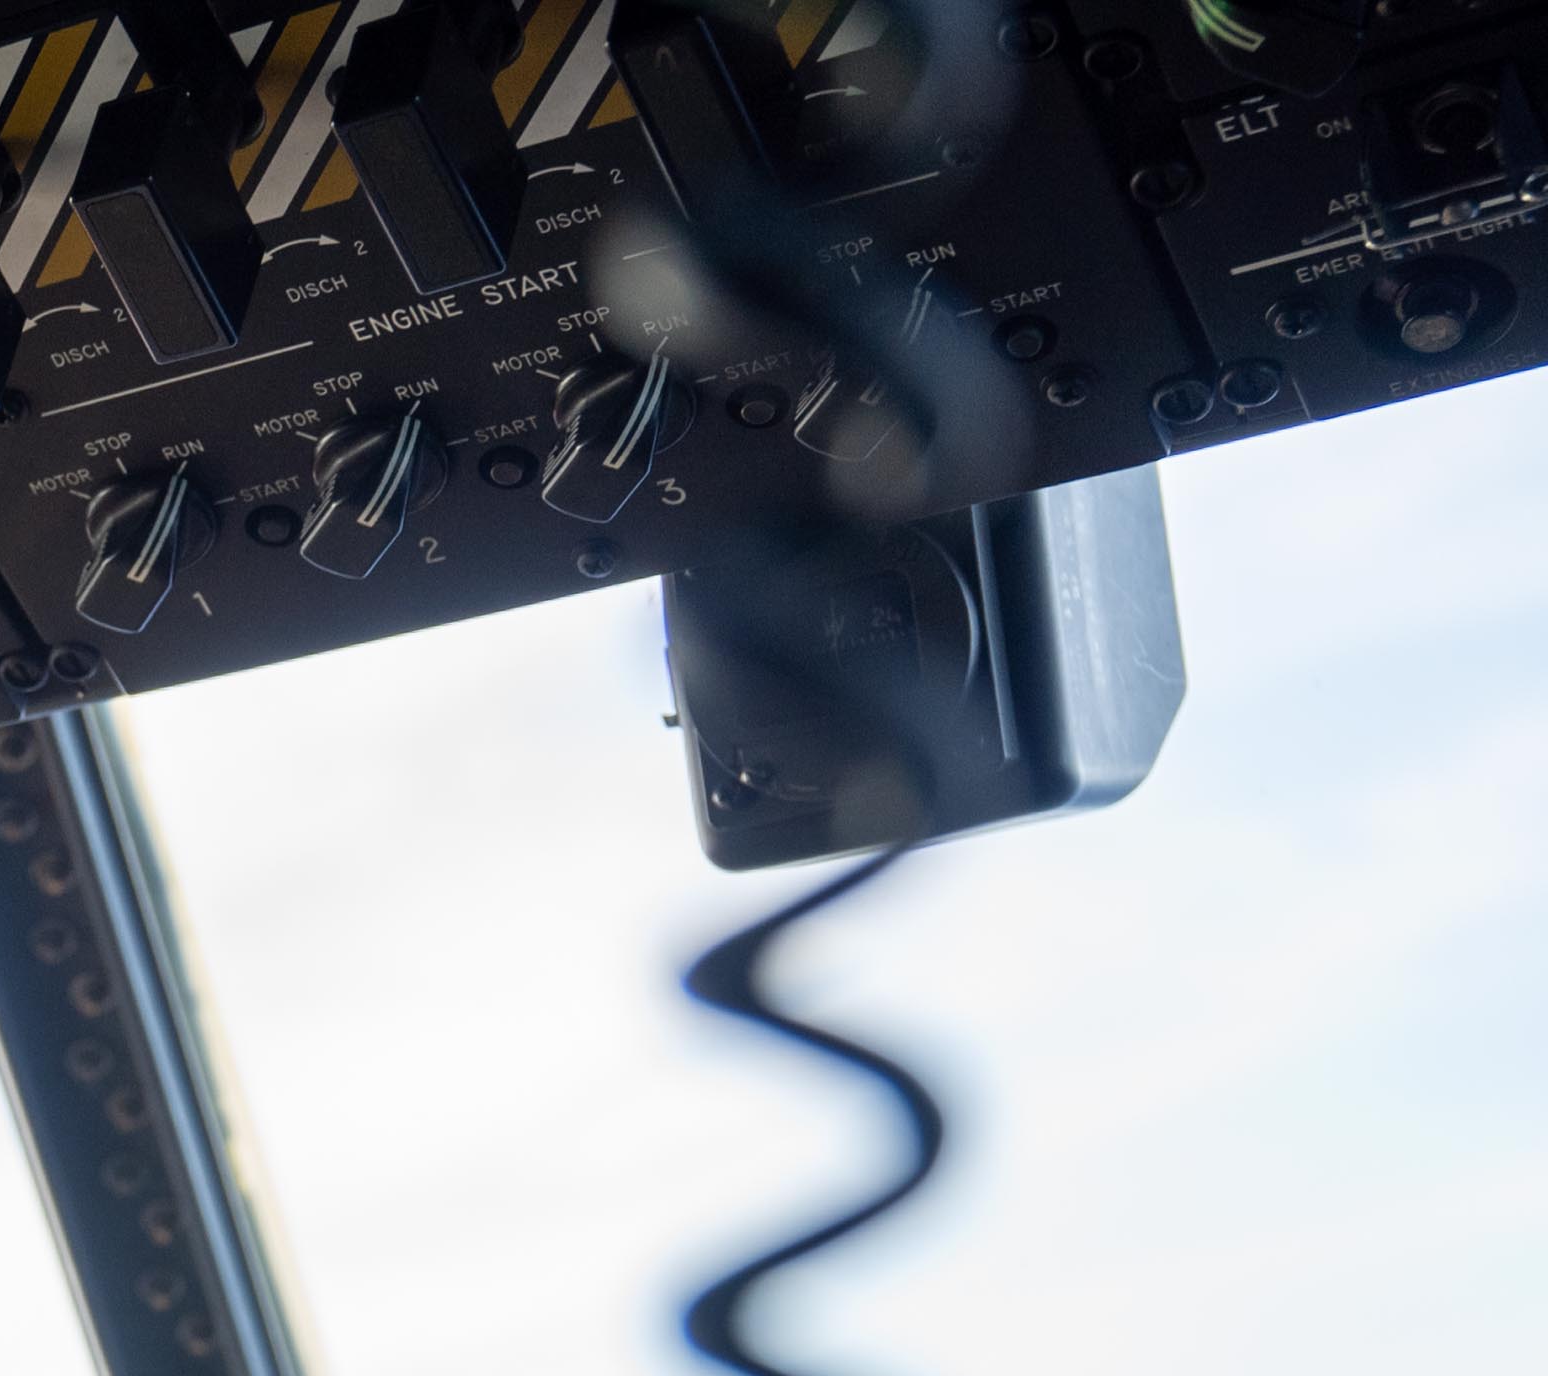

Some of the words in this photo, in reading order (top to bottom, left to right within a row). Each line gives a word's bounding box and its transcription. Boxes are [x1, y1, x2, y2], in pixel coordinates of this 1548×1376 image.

[1214, 103, 1281, 143] ELT
[1316, 117, 1353, 139] ON
[610, 169, 626, 186] 2
[535, 204, 603, 236] DISCH
[353, 241, 370, 256] 2
[819, 236, 874, 263] STOP
[905, 243, 956, 268] RUN
[1295, 253, 1365, 284] EMER
[285, 275, 348, 303] DISCH
[348, 295, 465, 342] ENGINE
[481, 261, 580, 306] START
[989, 282, 1062, 313] START
[113, 307, 128, 323] 2
[557, 306, 611, 333] STOP
[643, 314, 689, 336] RUN
[51, 340, 111, 368] DISCH
[492, 347, 562, 376] MOTOR
[724, 352, 791, 382] START
[313, 372, 363, 398] STOP
[394, 378, 440, 400] RUN
[254, 410, 320, 437] MOTOR
[474, 415, 540, 445] START
[84, 432, 133, 457] STOP
[161, 440, 206, 462] RUN
[28, 469, 92, 495] MOTOR
[240, 477, 300, 503] START
[657, 478, 687, 506] 3
[419, 537, 446, 564] 2
[192, 592, 212, 616] 1
